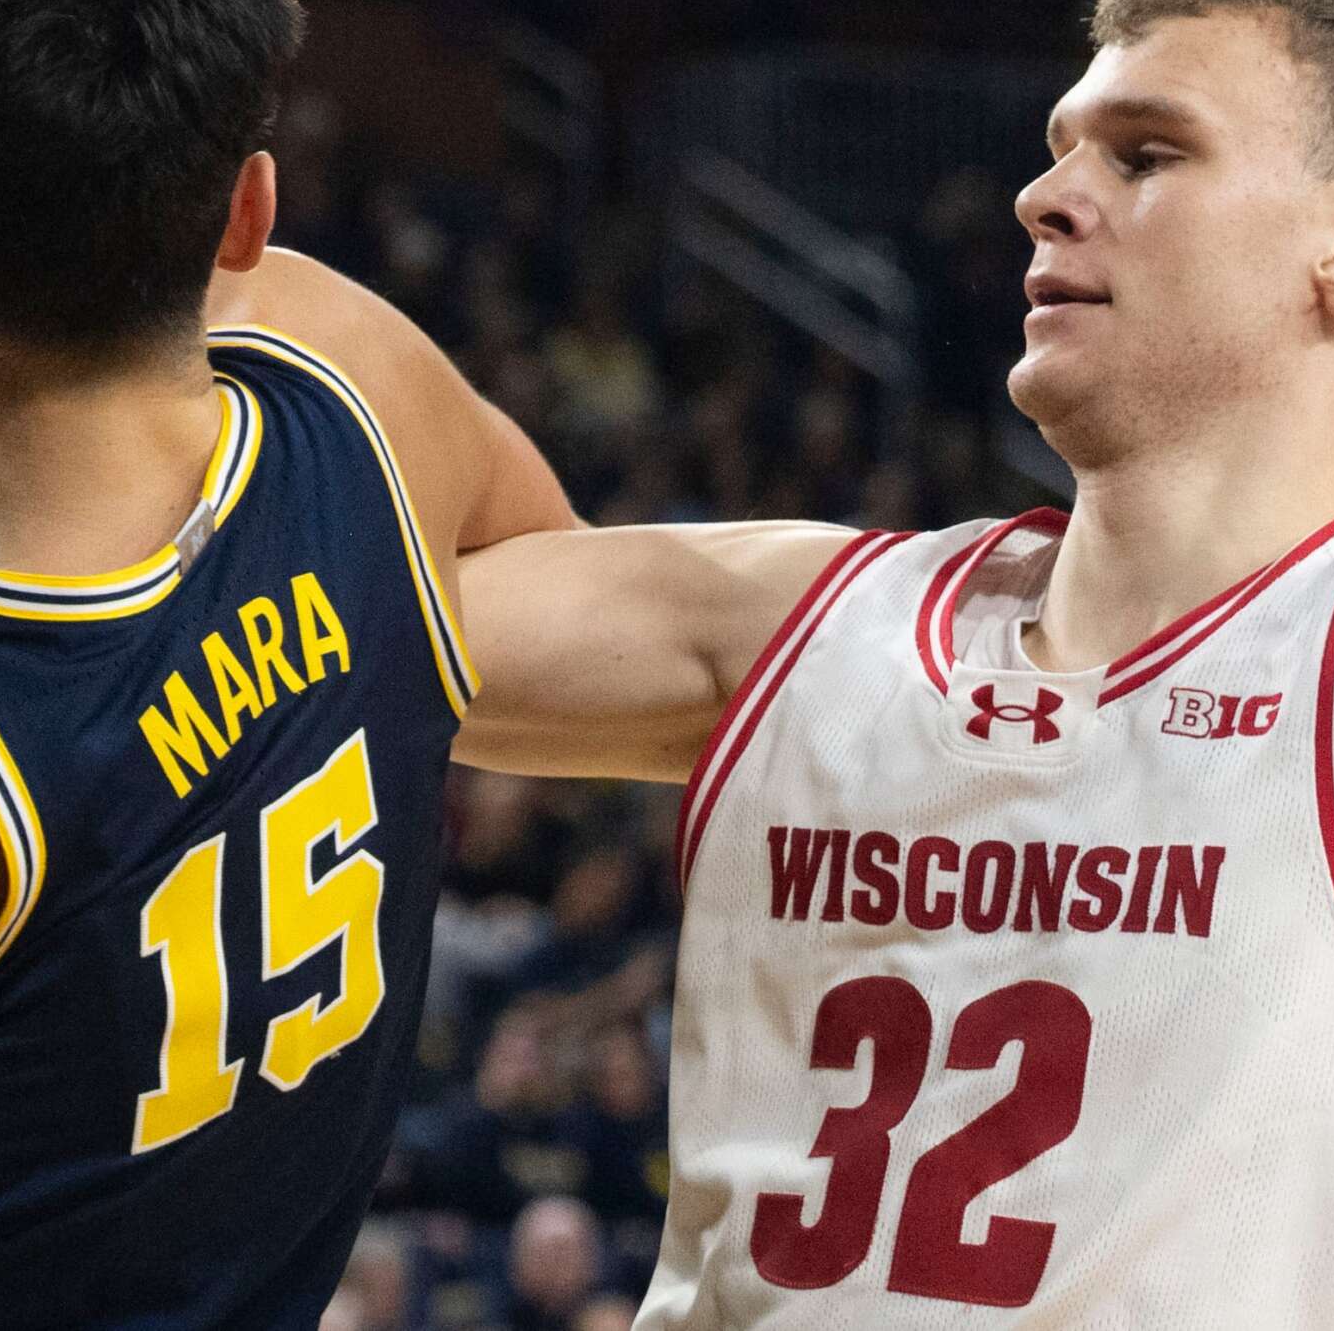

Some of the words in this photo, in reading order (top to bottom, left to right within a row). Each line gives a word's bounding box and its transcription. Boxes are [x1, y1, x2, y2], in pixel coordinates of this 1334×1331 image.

[138, 572, 351, 799] MARA
[130, 727, 385, 1155] 15
[767, 826, 1227, 938] WISCONSIN
[750, 975, 1093, 1308] 32
